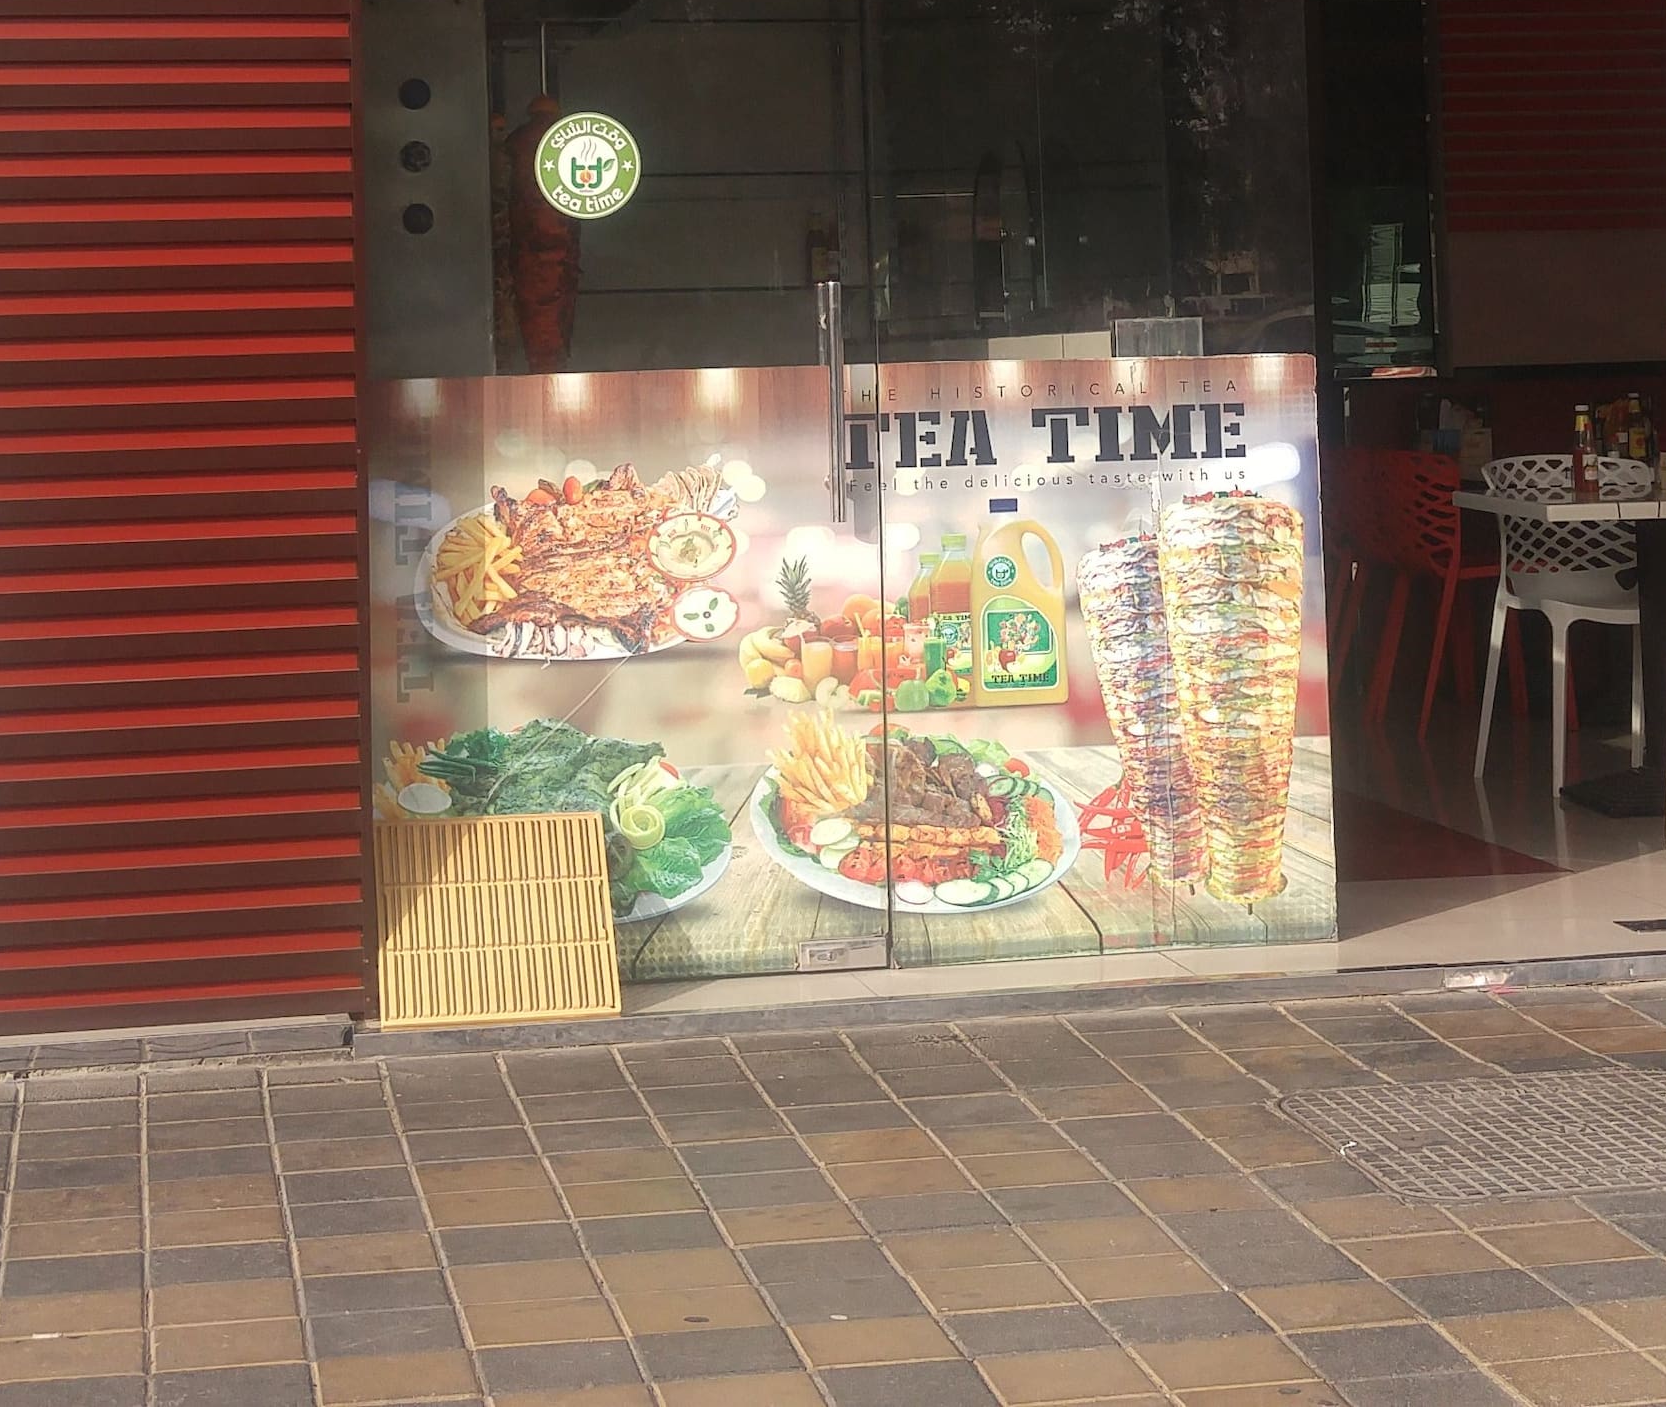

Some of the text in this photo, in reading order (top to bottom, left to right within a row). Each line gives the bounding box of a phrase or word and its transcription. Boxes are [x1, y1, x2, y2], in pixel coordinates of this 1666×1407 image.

[551, 185, 624, 213] tea time
[845, 379, 1237, 403] HE HISTORICAL TEA
[844, 401, 1247, 471] TEA TIME
[913, 477, 949, 491] the
[964, 473, 1075, 490] delicious
[1162, 468, 1210, 483] with
[1224, 468, 1247, 481] us
